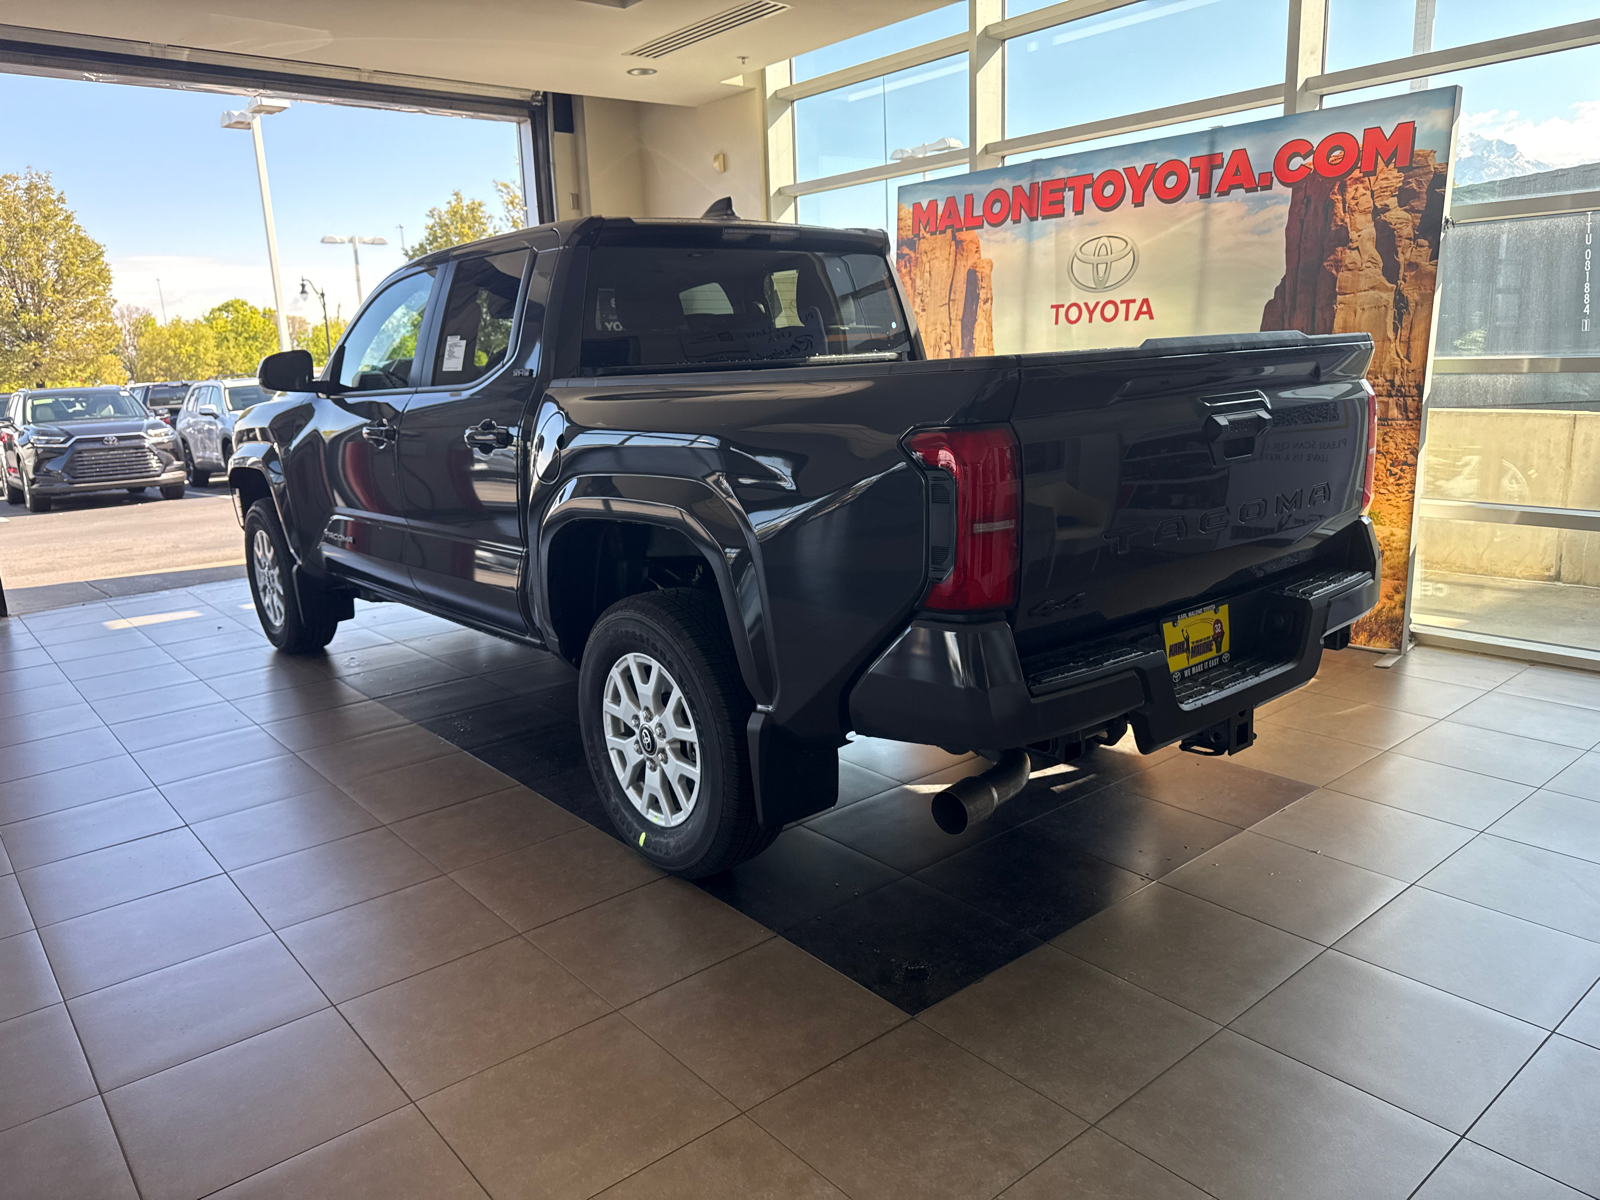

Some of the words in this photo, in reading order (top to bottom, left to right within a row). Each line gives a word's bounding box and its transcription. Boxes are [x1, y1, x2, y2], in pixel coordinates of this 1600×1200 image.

[911, 121, 1417, 236] MALONETOYOTA.COM
[1583, 249, 1591, 315] 081884
[1049, 297, 1155, 326] TOYOTA
[1103, 481, 1331, 555] TACOMA
[1214, 623, 1222, 633] 32
[1183, 667, 1191, 677] WE
[1191, 664, 1204, 675] MAKE
[1203, 661, 1209, 670] IT
[1208, 657, 1220, 668] EASY
